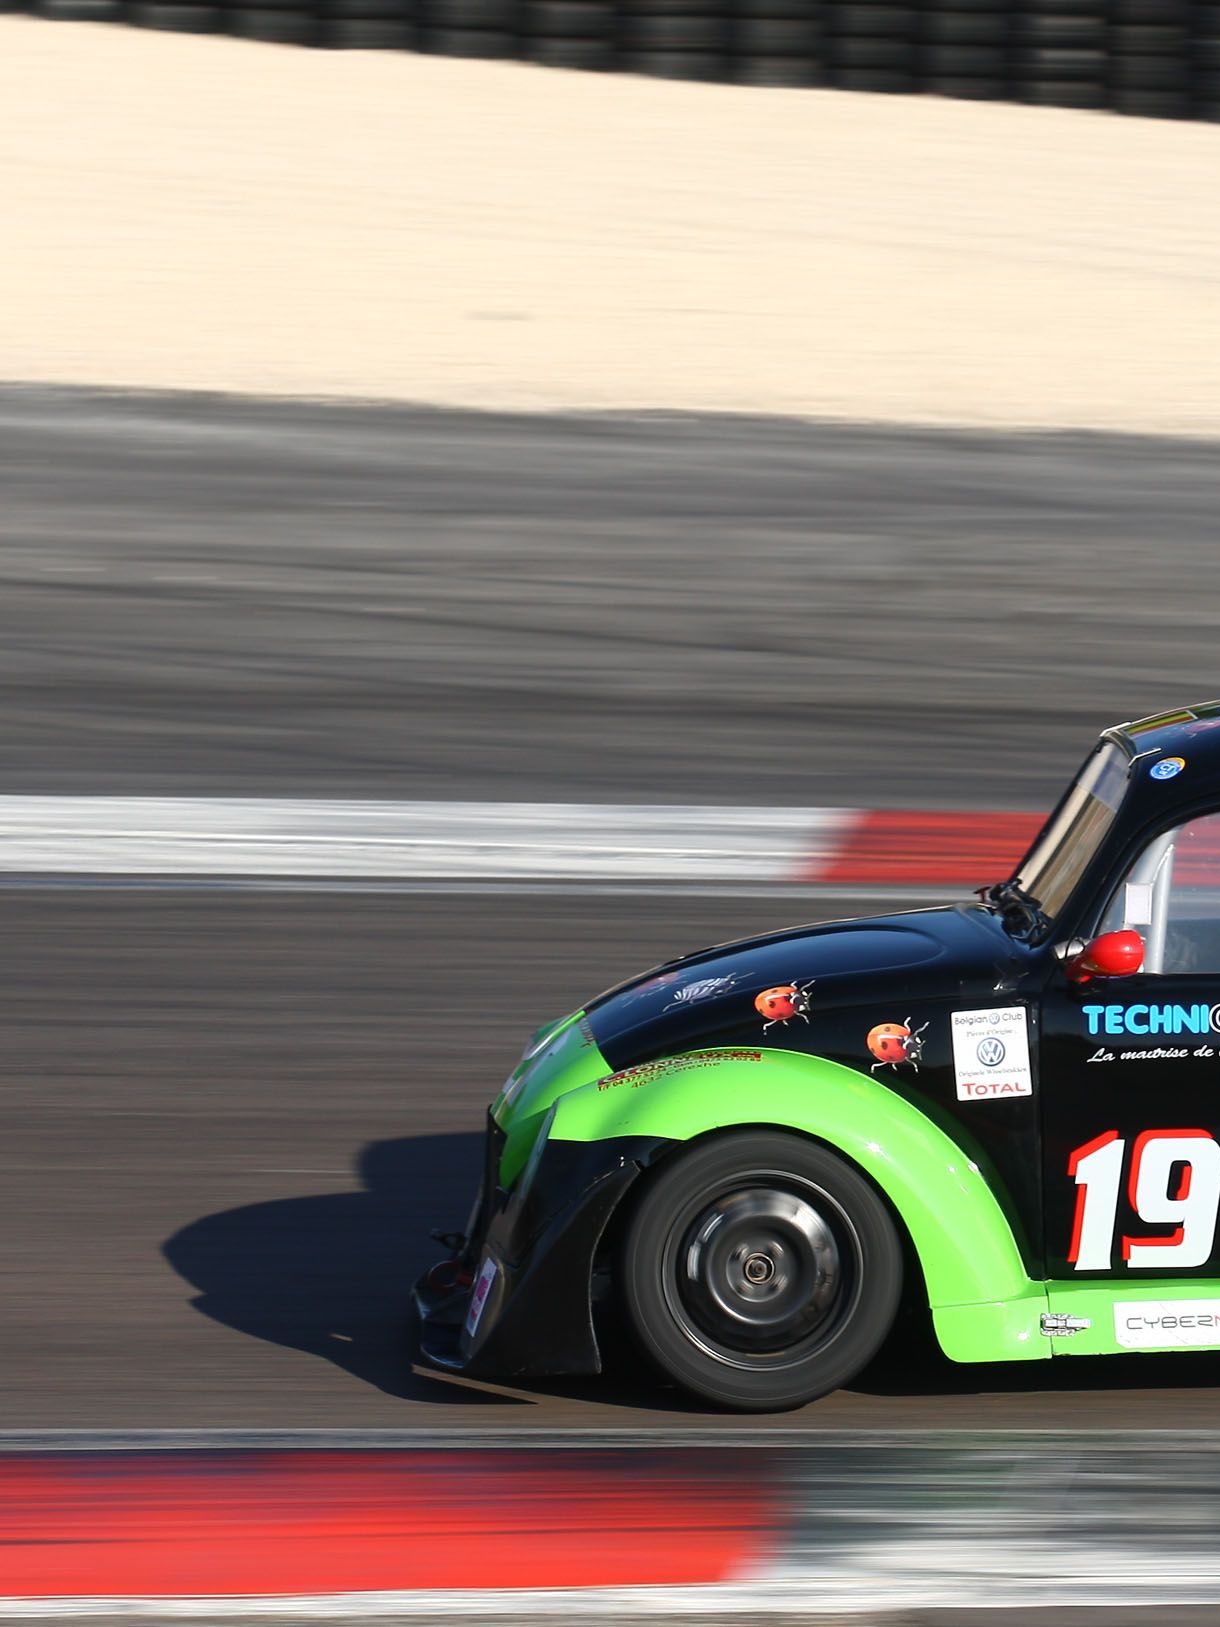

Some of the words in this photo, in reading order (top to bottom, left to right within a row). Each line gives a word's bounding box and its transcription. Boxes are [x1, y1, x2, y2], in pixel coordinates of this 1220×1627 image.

[954, 1015, 988, 1025] Belgian
[1001, 1012, 1024, 1022] Club
[1086, 1047, 1116, 1063] La
[1193, 1044, 1214, 1058] de
[962, 1082, 1027, 1096] TOTAL
